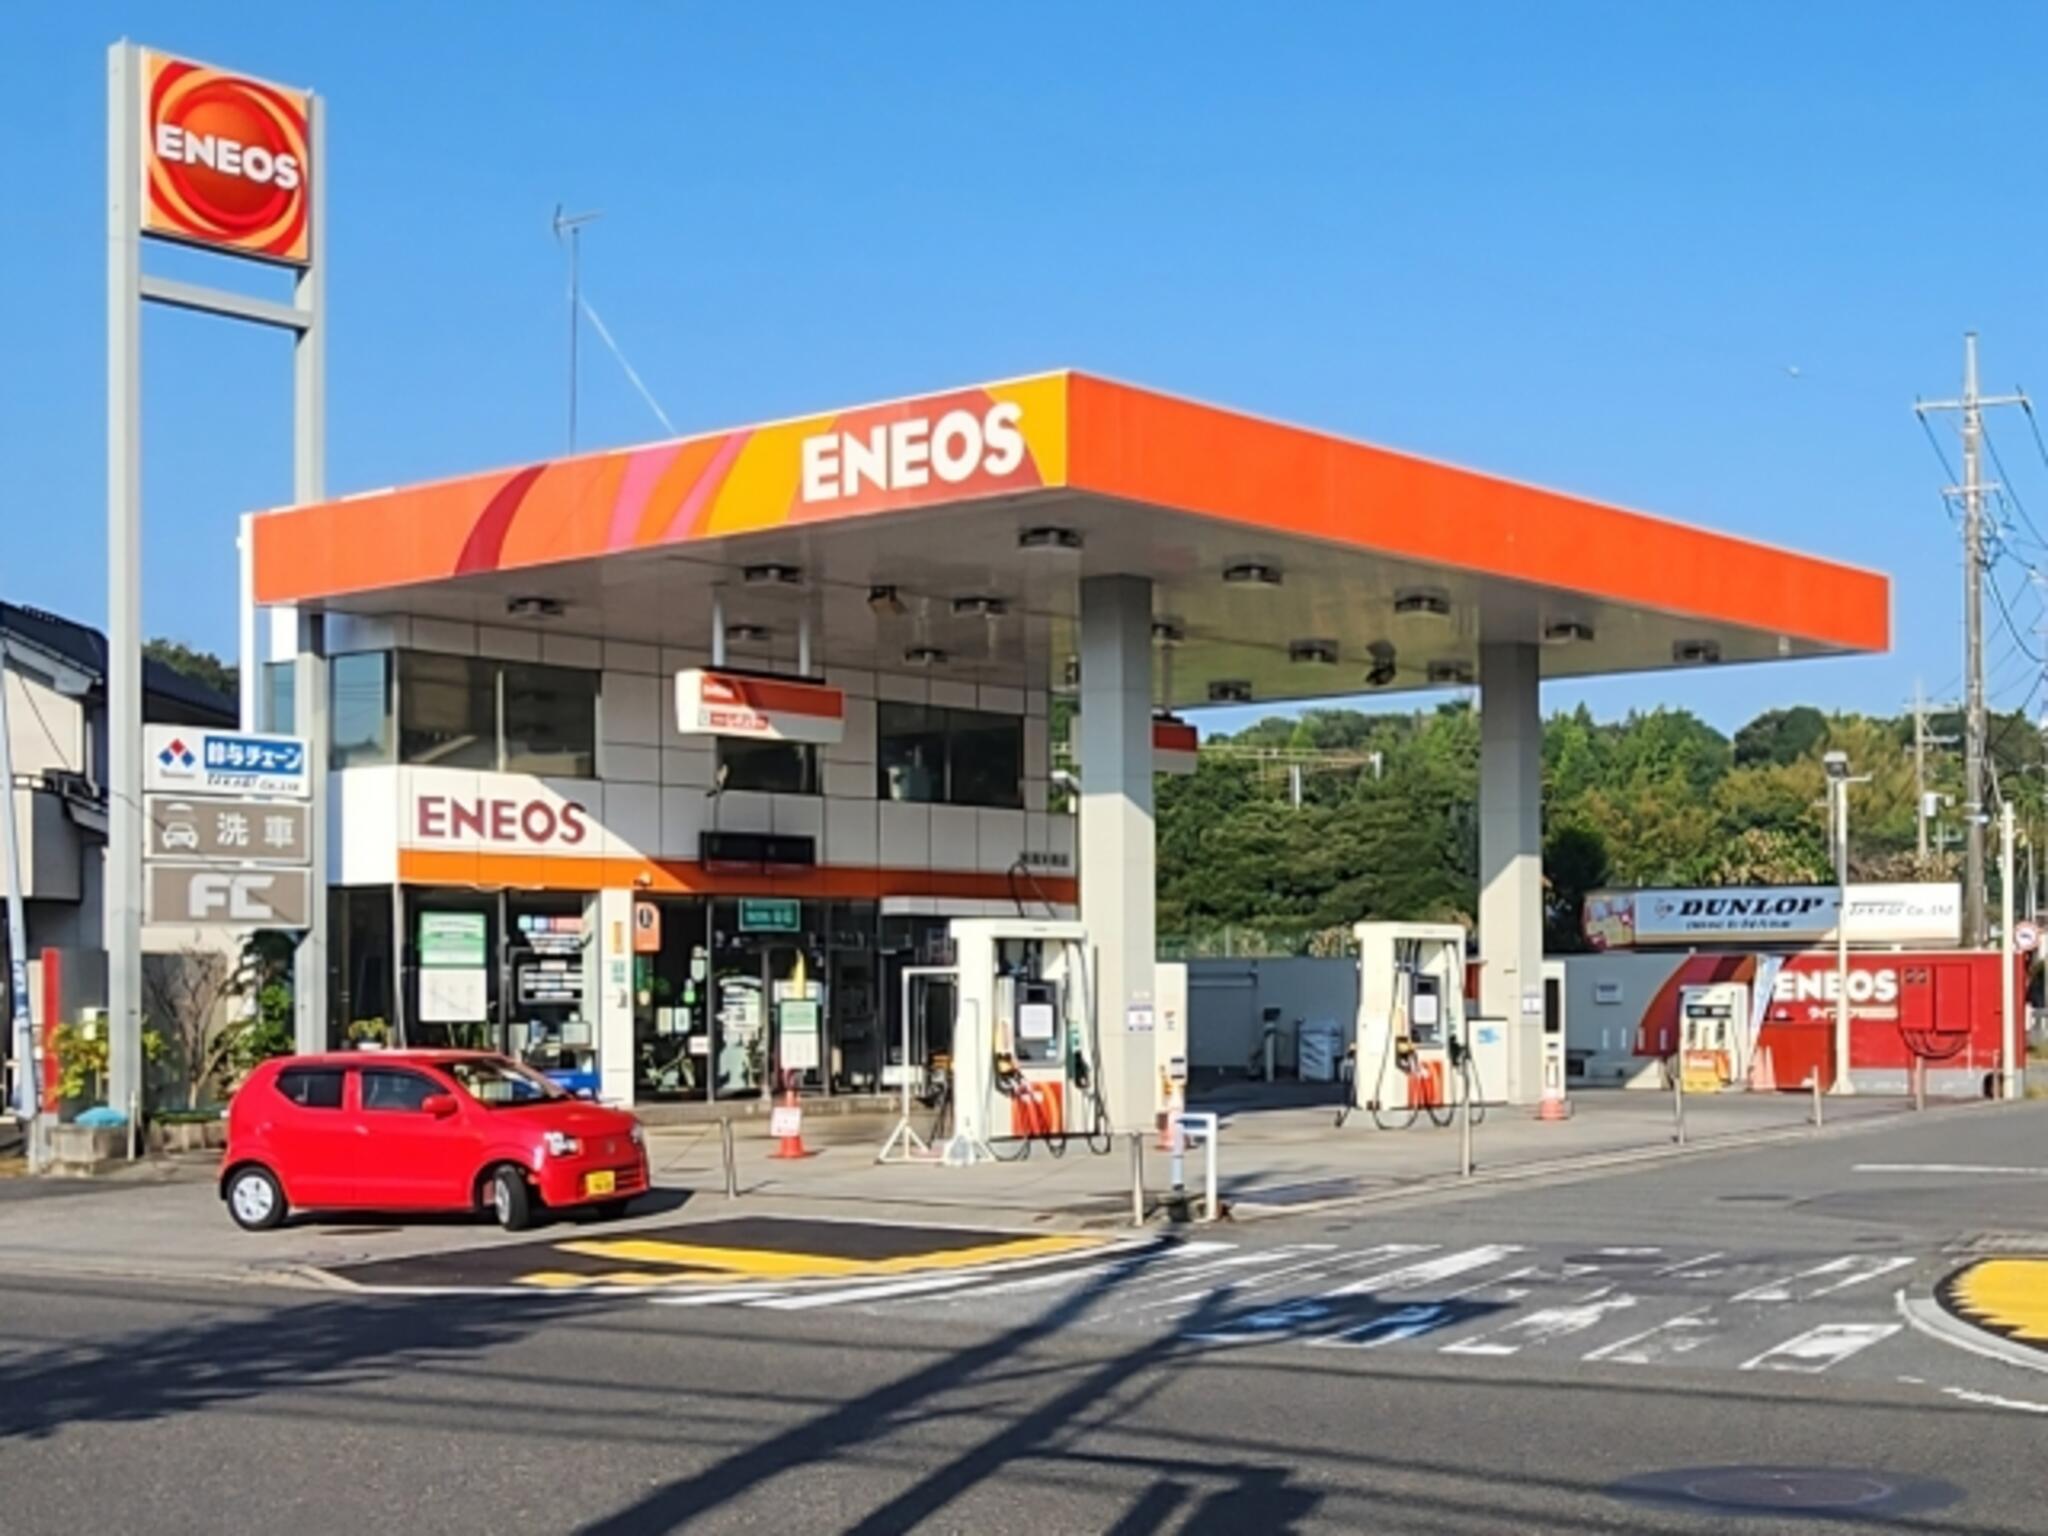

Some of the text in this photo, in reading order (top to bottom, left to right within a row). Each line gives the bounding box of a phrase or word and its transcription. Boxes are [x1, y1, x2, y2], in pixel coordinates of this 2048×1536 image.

[156, 123, 300, 190] ENEOS
[802, 401, 1025, 504] ENEOS
[216, 811, 295, 849] 洗車
[418, 796, 587, 845] ENEOS
[188, 873, 276, 919] FC
[1679, 898, 1825, 916] DUNLOP
[1773, 969, 1898, 1002] ENEOS
